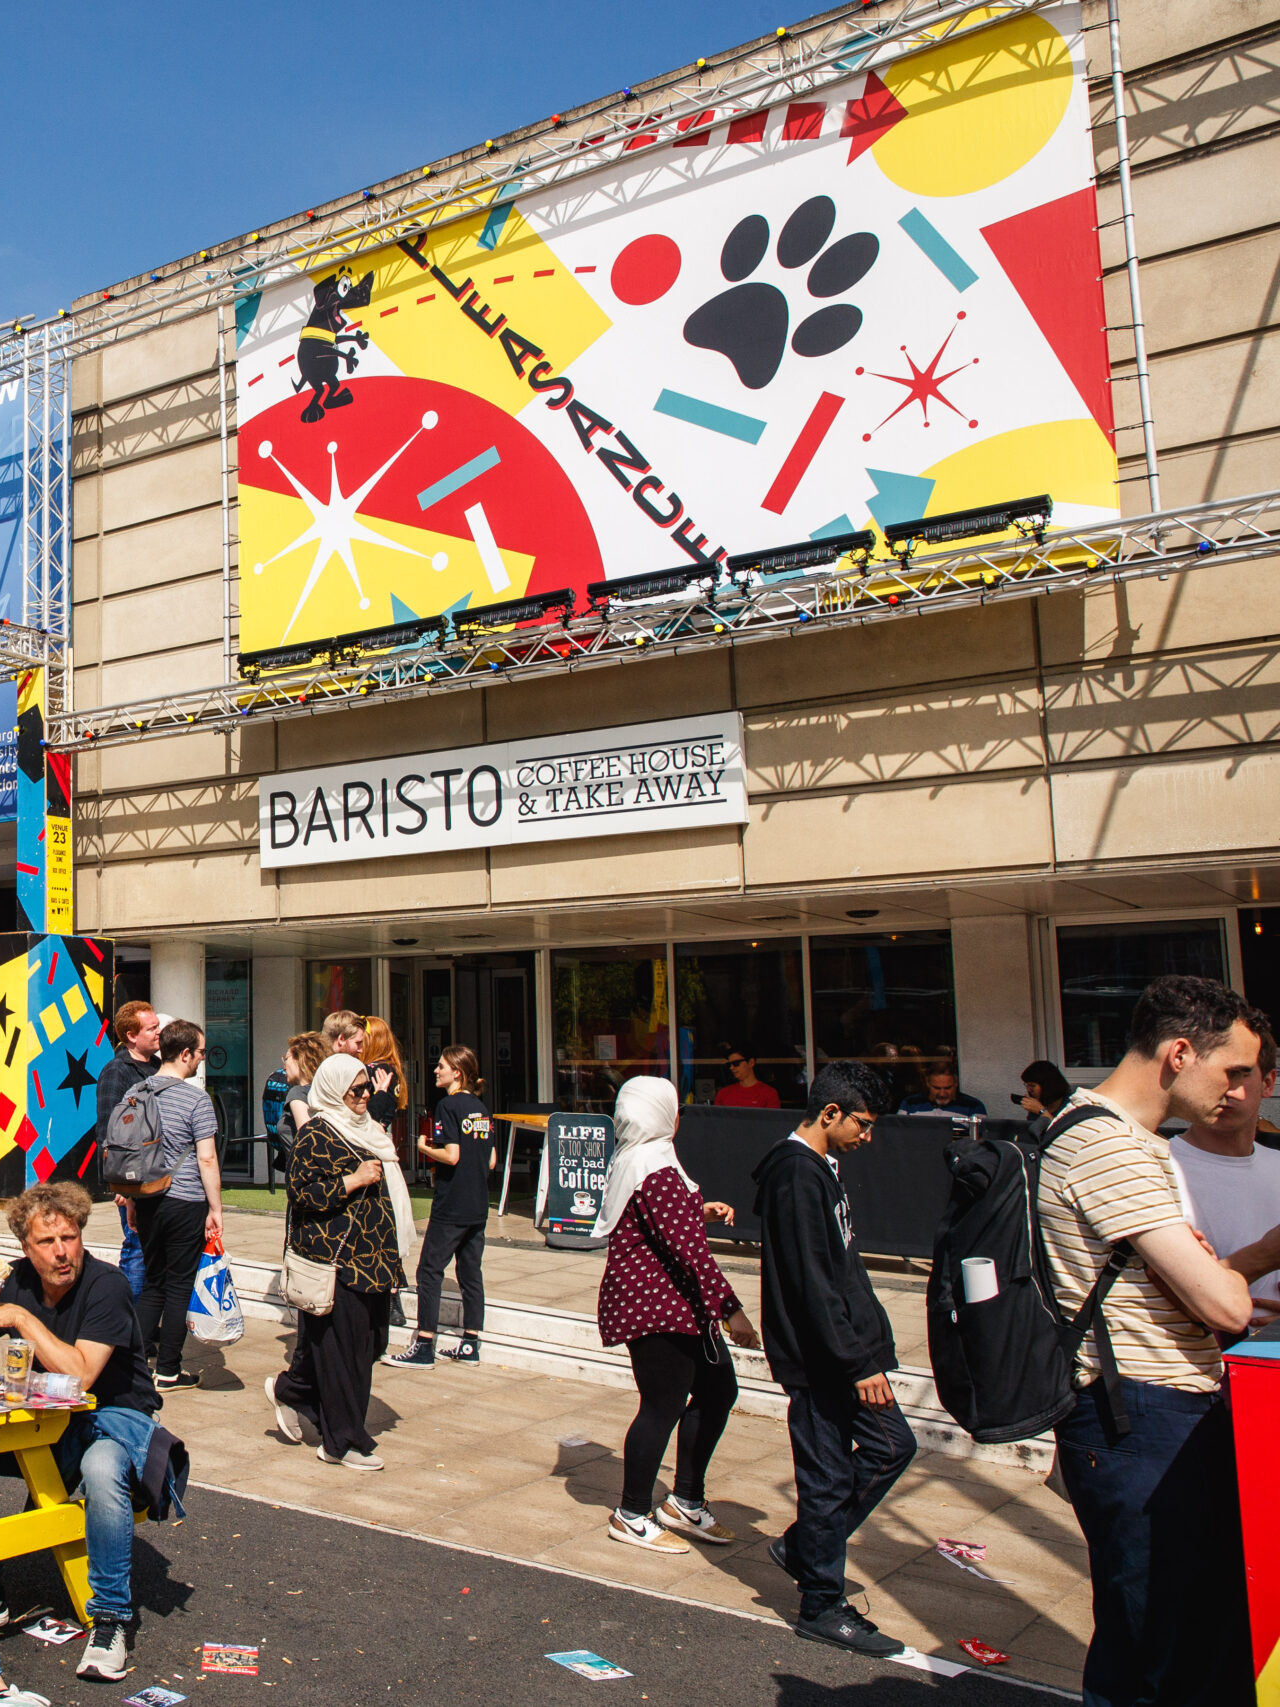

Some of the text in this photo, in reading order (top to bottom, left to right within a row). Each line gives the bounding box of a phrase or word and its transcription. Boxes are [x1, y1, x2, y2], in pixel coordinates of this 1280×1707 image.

[396, 222, 727, 564] PLEASANCE
[517, 742, 726, 788] COFFEE HOUSE
[518, 769, 726, 816] & TAKE AWAY
[270, 765, 502, 849] BARISTO
[51, 824, 68, 832] VENUE
[53, 832, 66, 844] 23
[558, 1125, 605, 1141] LIFE
[558, 1139, 605, 1158] IS TOO SHORT
[559, 1156, 605, 1169] for bad
[558, 1167, 606, 1191] Coffee
